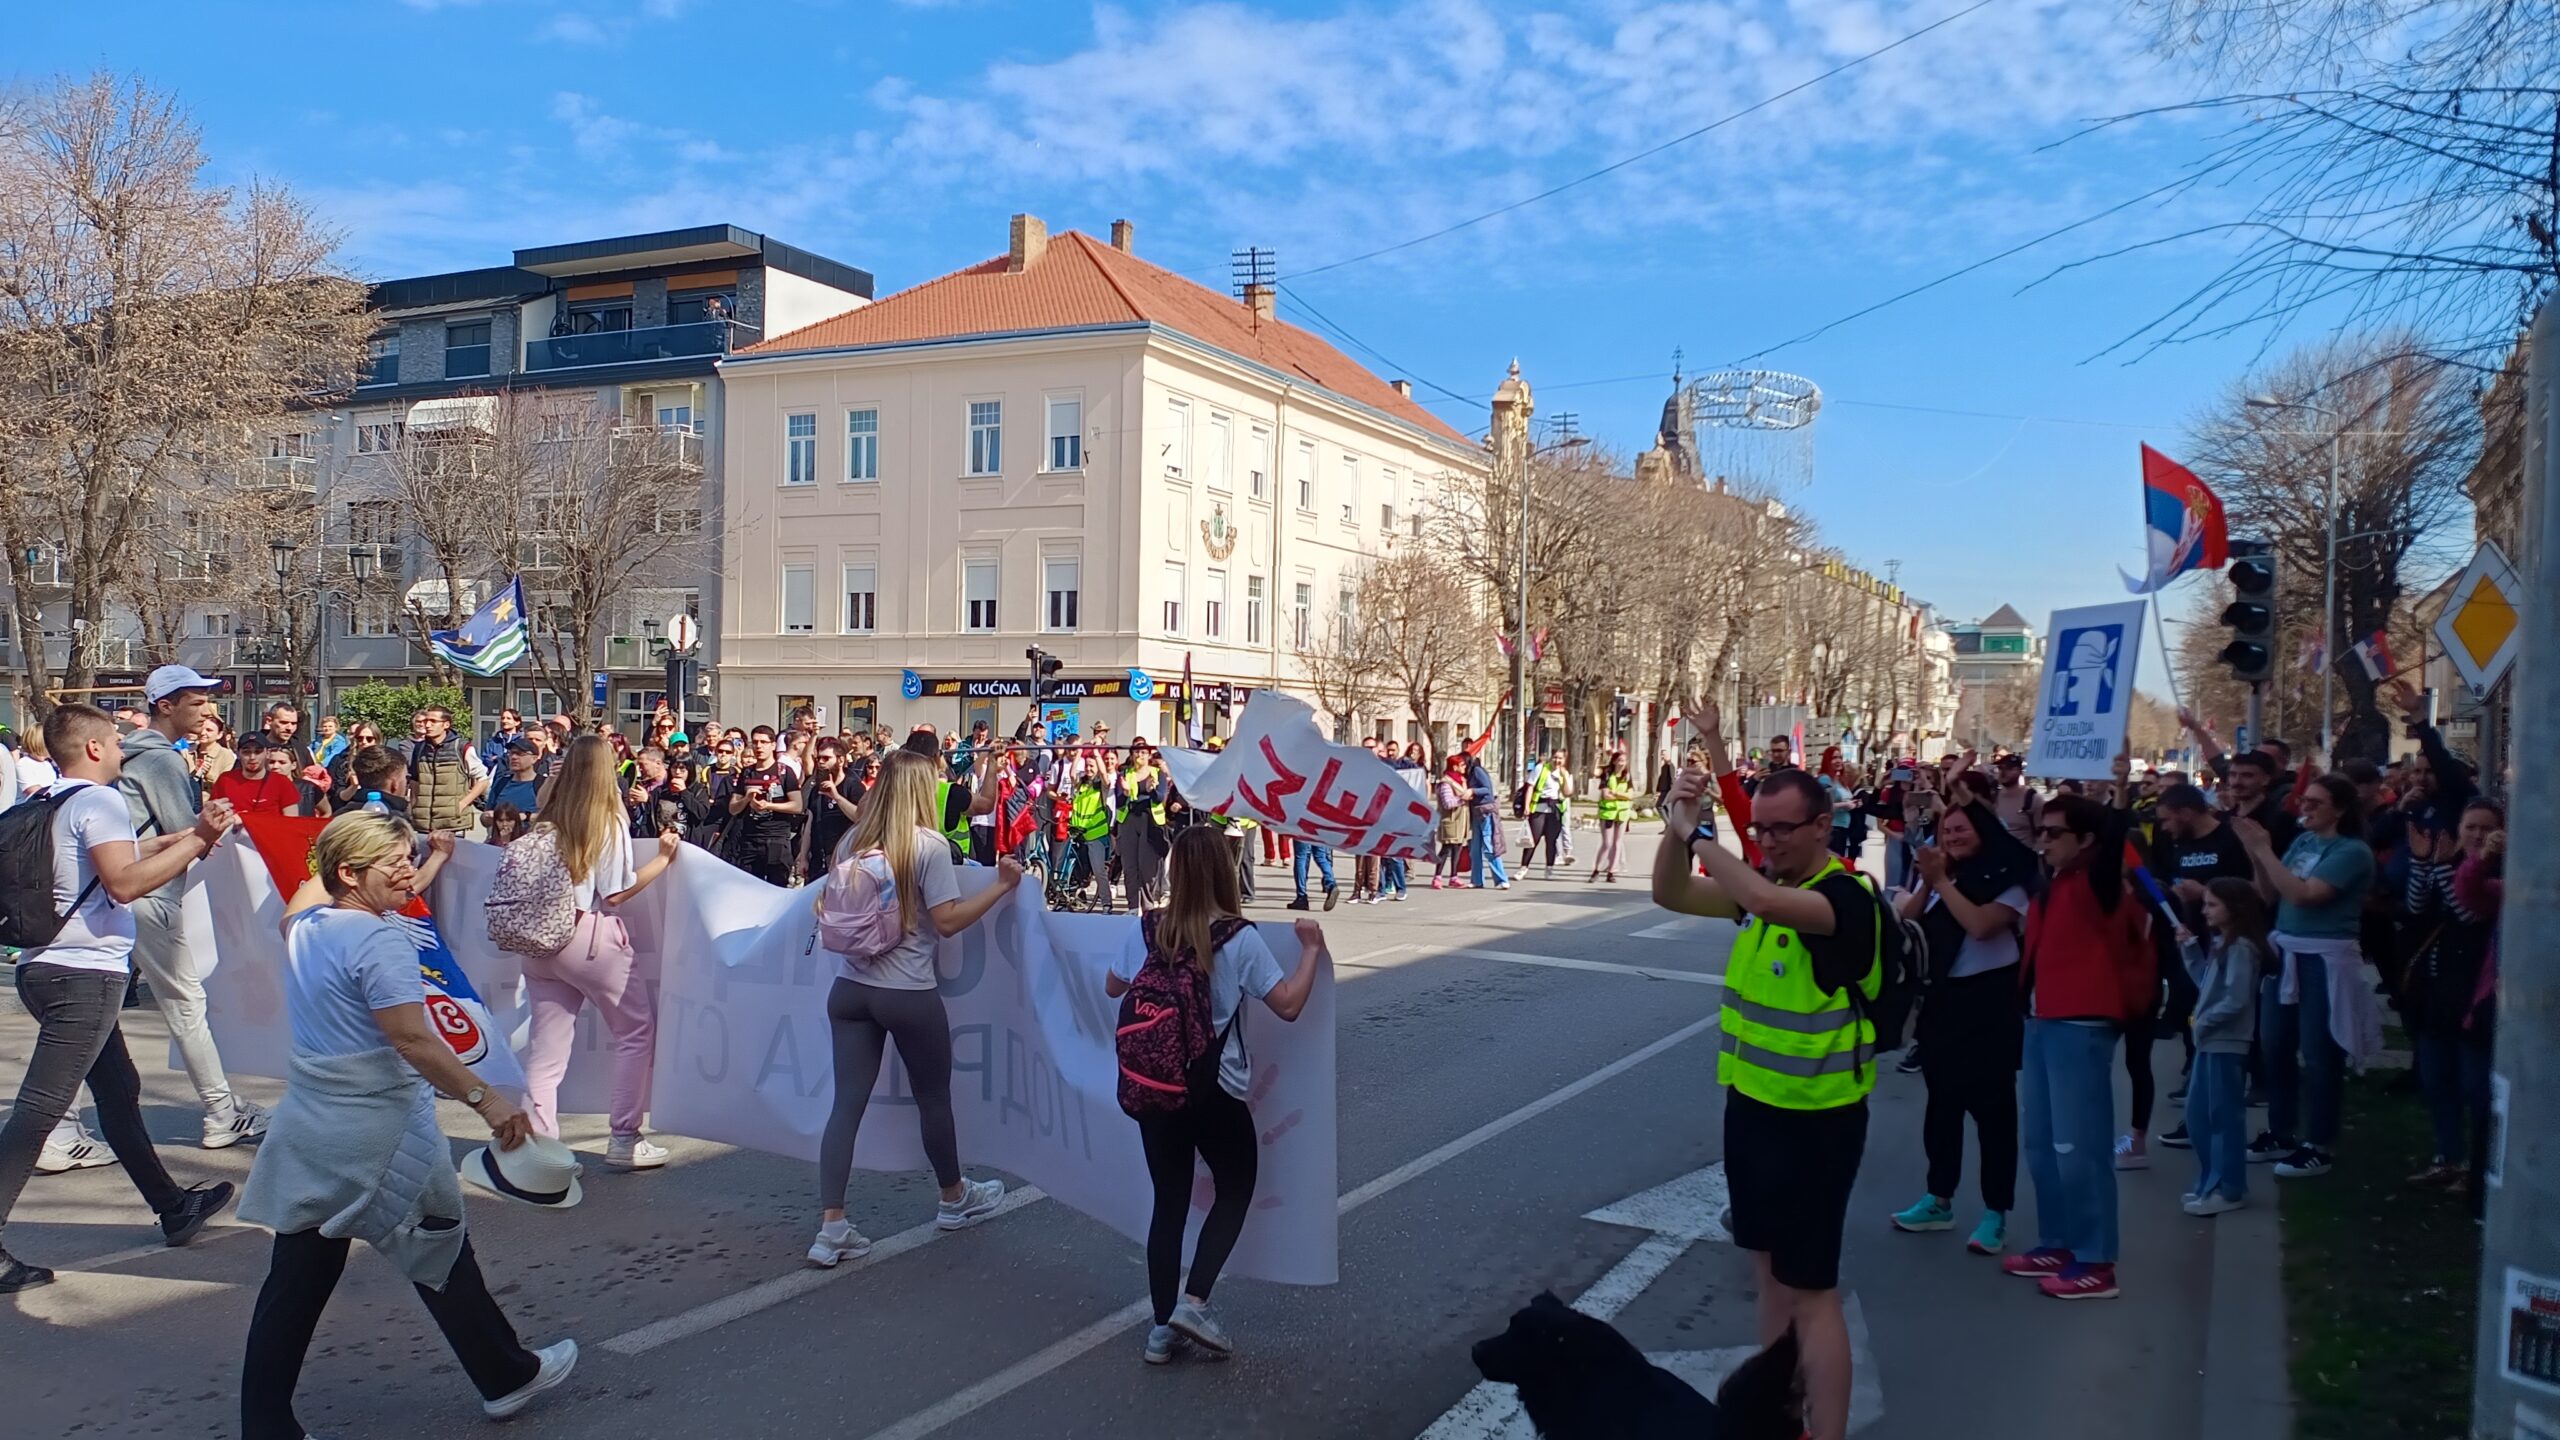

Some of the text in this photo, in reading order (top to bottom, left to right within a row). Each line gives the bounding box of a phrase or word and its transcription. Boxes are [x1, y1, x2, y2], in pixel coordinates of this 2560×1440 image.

[935, 681, 962, 694] neon
[968, 680, 1022, 696] KUĆNA
[1092, 681, 1120, 694] neon
[2179, 852, 2219, 868] adidas
[1135, 998, 1161, 1017] VAN
